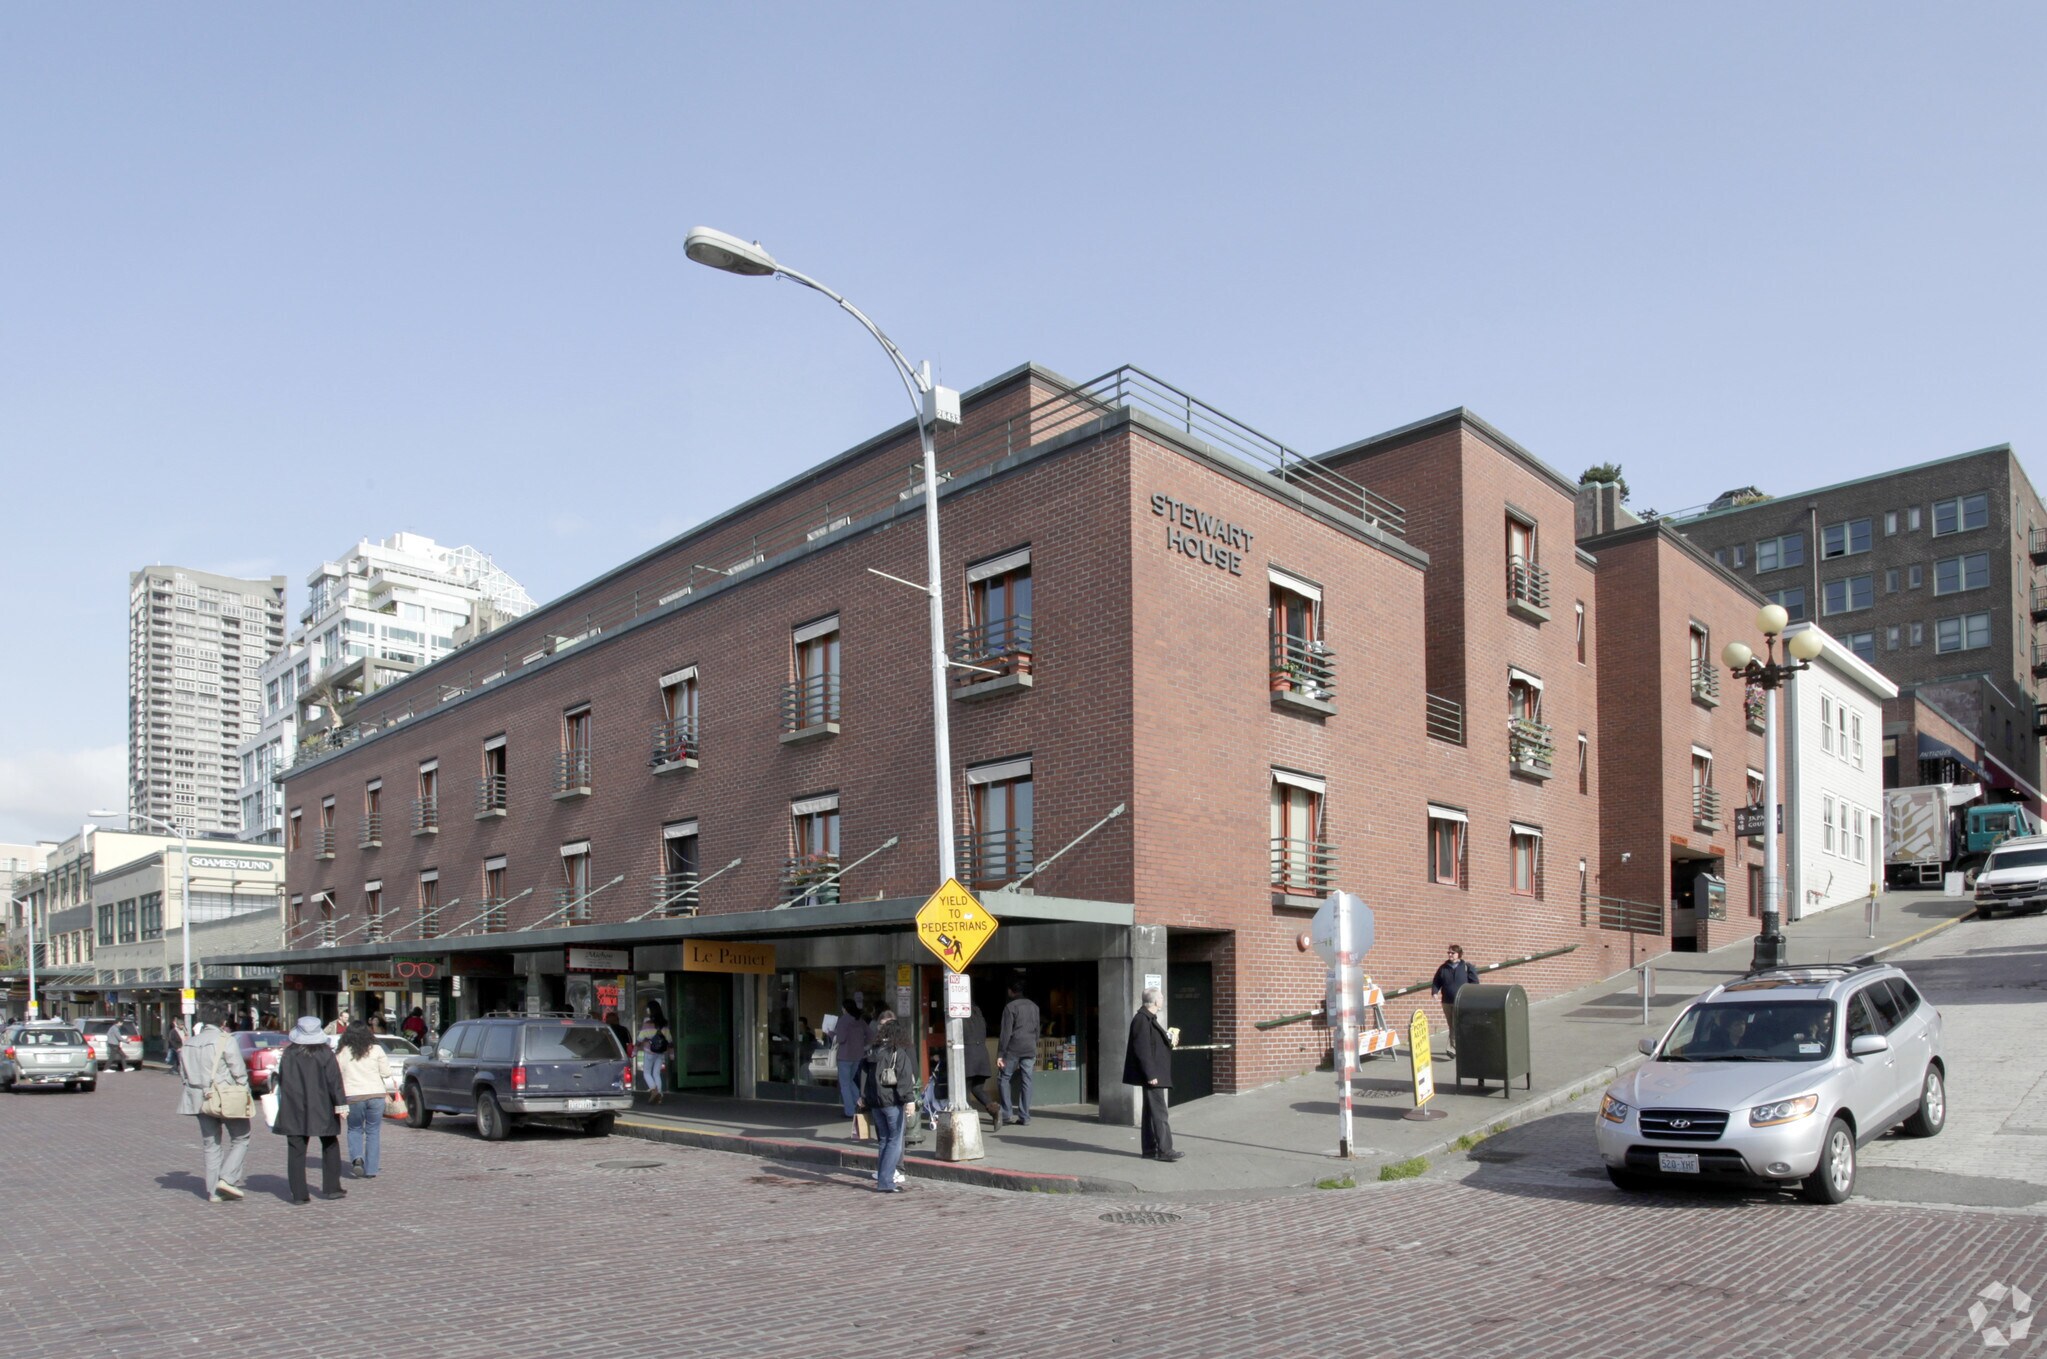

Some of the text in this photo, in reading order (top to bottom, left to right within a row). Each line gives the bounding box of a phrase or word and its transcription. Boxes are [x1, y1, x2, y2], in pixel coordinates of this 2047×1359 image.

[1151, 492, 1254, 553] STEWART
[1167, 526, 1243, 577] HOUSE
[1919, 748, 1952, 758] ANTIQUES
[191, 856, 270, 871] SOAMES/DUNN
[939, 896, 968, 906] YIELD
[949, 908, 961, 919] TO
[921, 920, 988, 933] PEDESTRIANS
[693, 943, 767, 967] Le Panier
